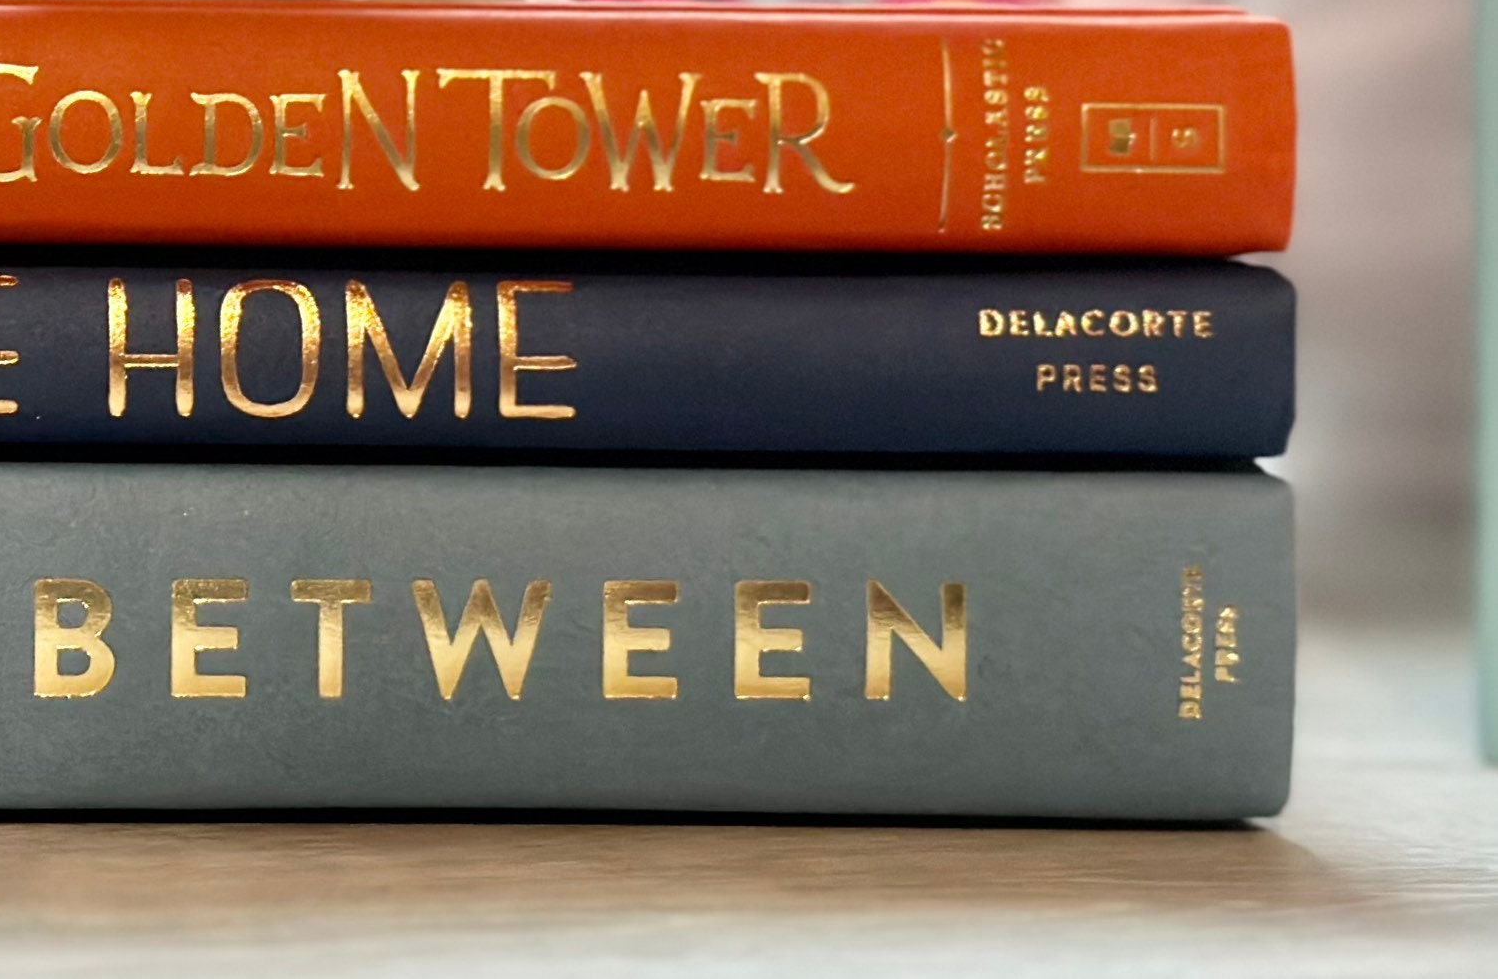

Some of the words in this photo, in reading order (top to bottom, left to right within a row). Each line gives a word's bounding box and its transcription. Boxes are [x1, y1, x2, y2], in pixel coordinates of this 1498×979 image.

[436, 68, 855, 194] TOWER
[980, 38, 1008, 230] SCHOLASTIC
[1023, 86, 1050, 185] PRESS
[108, 278, 577, 418] HOME
[977, 308, 1215, 338] DELACORTE
[1036, 364, 1159, 392] PRESS
[33, 578, 968, 701] BETWEEN
